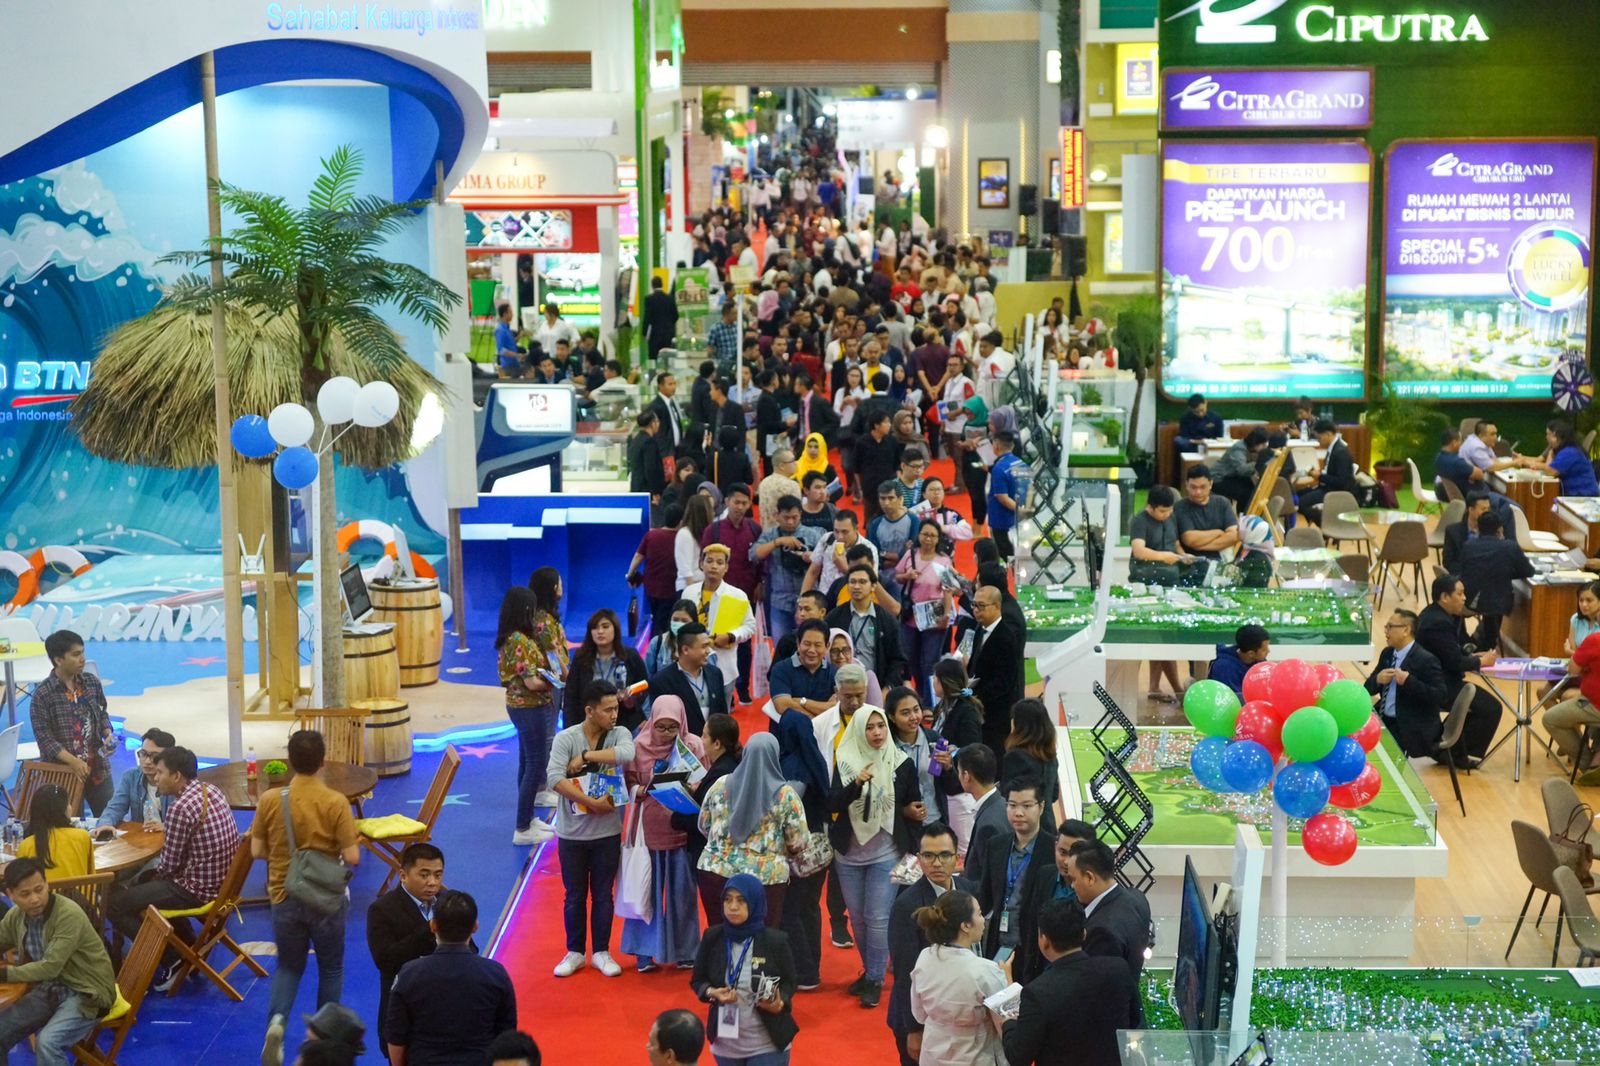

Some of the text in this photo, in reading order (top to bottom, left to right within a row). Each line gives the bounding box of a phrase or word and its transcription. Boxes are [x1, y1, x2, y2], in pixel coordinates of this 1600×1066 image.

[267, 3, 358, 30] Sahabat
[366, 4, 433, 36] Keluarga
[1296, 5, 1490, 42] CIPUTRA
[457, 173, 547, 190] IMA GROUP
[1206, 168, 1327, 179] TIPE TERBARU
[1206, 187, 1326, 201] DAPATKAN HARGA
[1407, 192, 1571, 207] RUMAH MEWAH 2 LANTAI
[1185, 200, 1346, 222] PRE-LAUNCH
[1402, 207, 1575, 222] DI PUSAT BISNIS CIBUBUR
[1197, 226, 1295, 273] 700
[1400, 238, 1465, 254] SPECIAL
[1400, 253, 1466, 265] DISCOUNT
[13, 361, 91, 391] BTN
